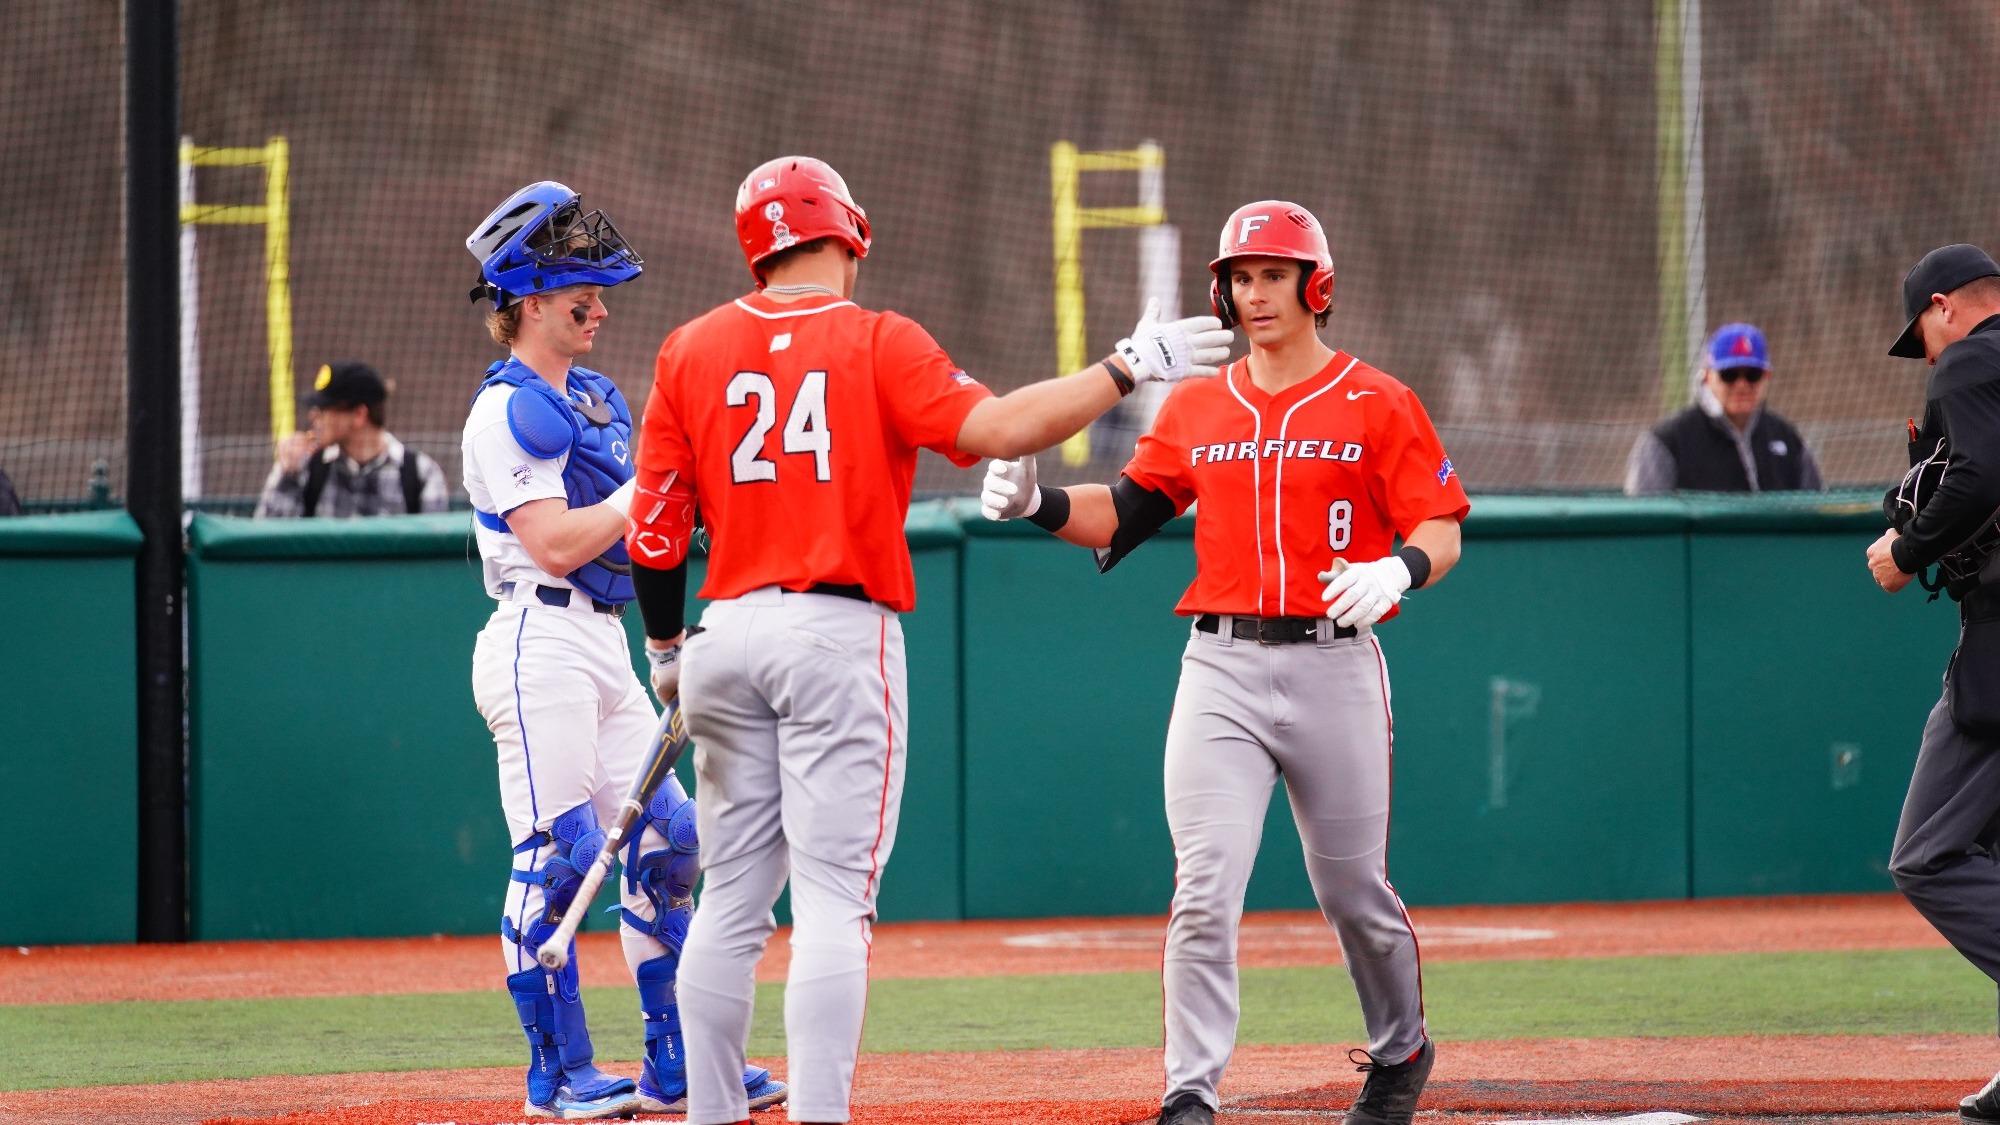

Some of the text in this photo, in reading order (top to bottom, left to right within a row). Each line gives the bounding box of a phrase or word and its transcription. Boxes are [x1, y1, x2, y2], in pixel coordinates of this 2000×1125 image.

[1238, 215, 1270, 245] F
[725, 370, 832, 485] 24
[1191, 439, 1363, 467] FAIRFIELD
[1328, 498, 1353, 552] 8
